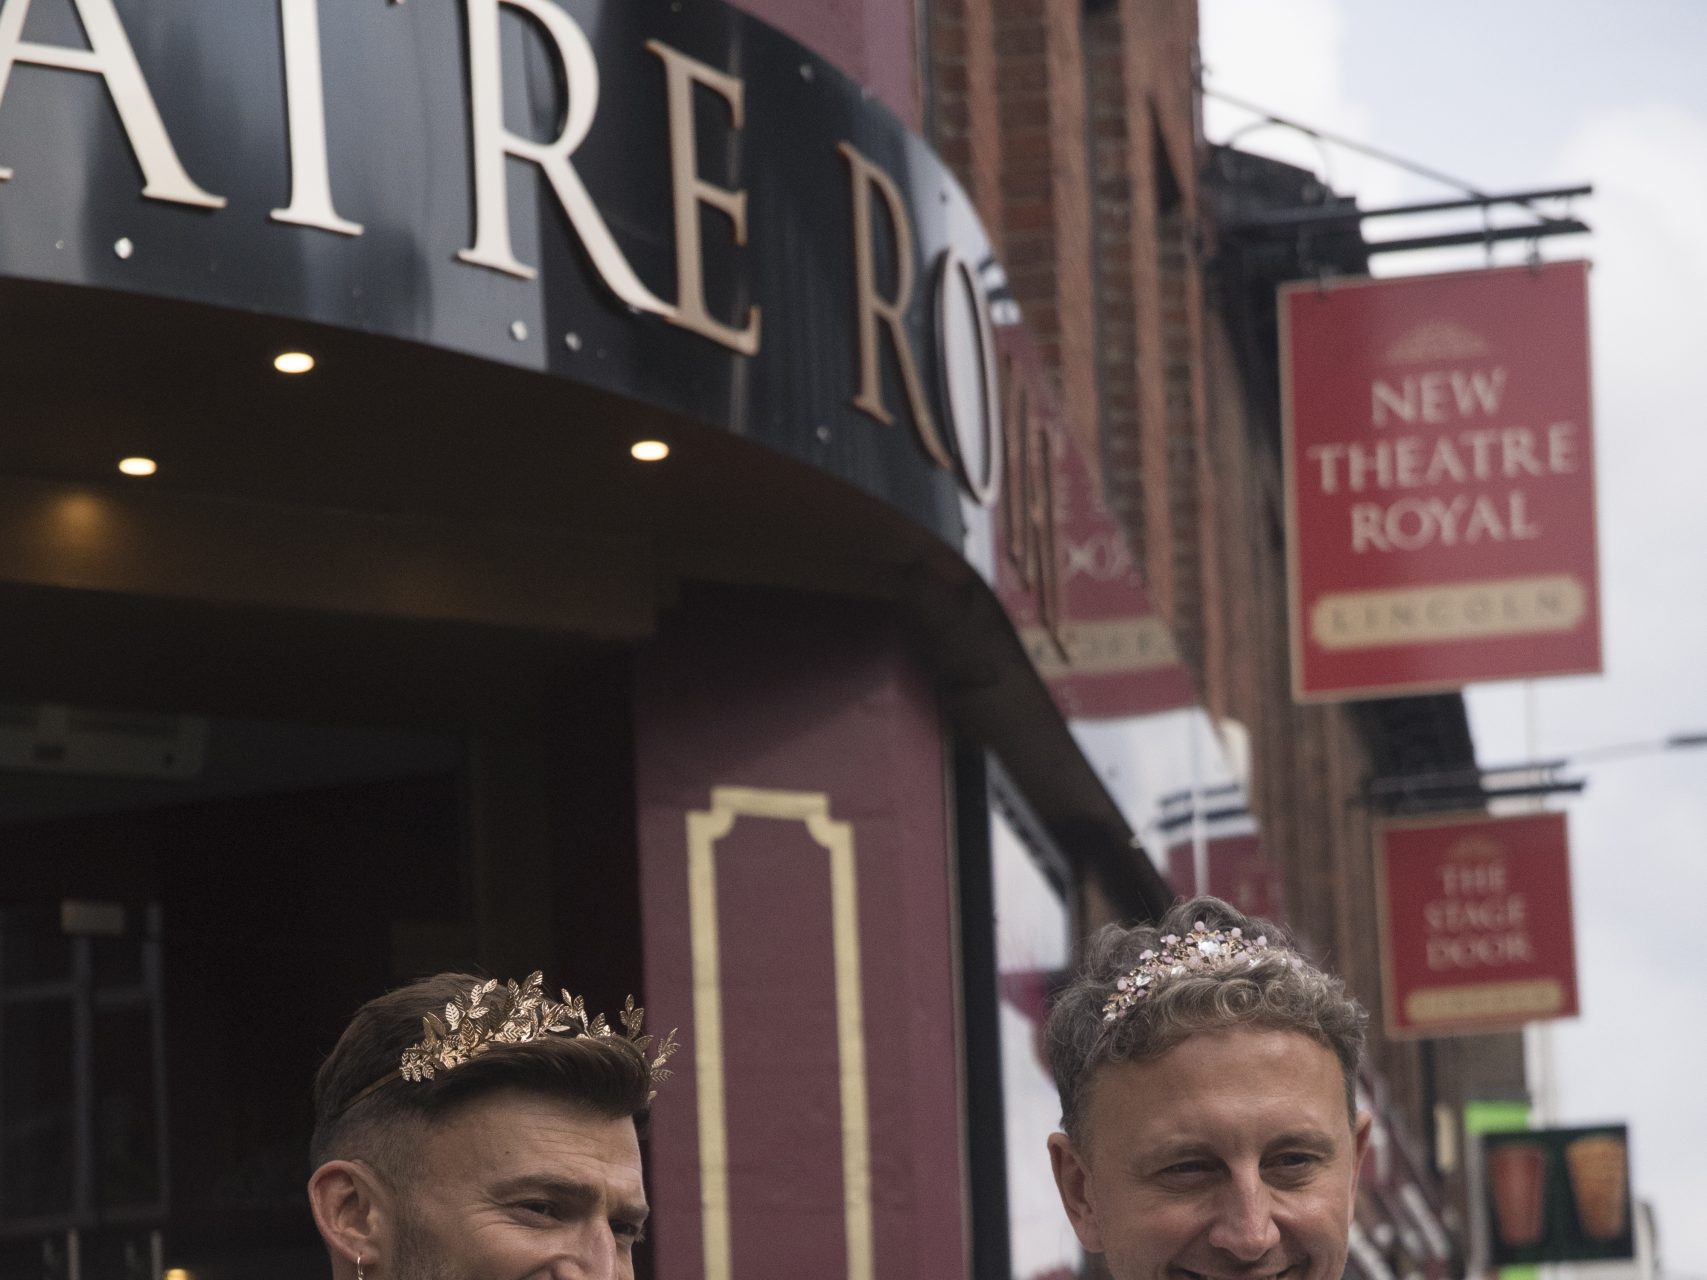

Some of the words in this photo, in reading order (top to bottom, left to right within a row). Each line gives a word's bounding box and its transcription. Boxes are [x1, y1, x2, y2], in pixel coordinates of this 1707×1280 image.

[1371, 366, 1508, 427] NEW
[1308, 421, 1580, 494] THEATRE
[1351, 490, 1540, 554] ROYAL
